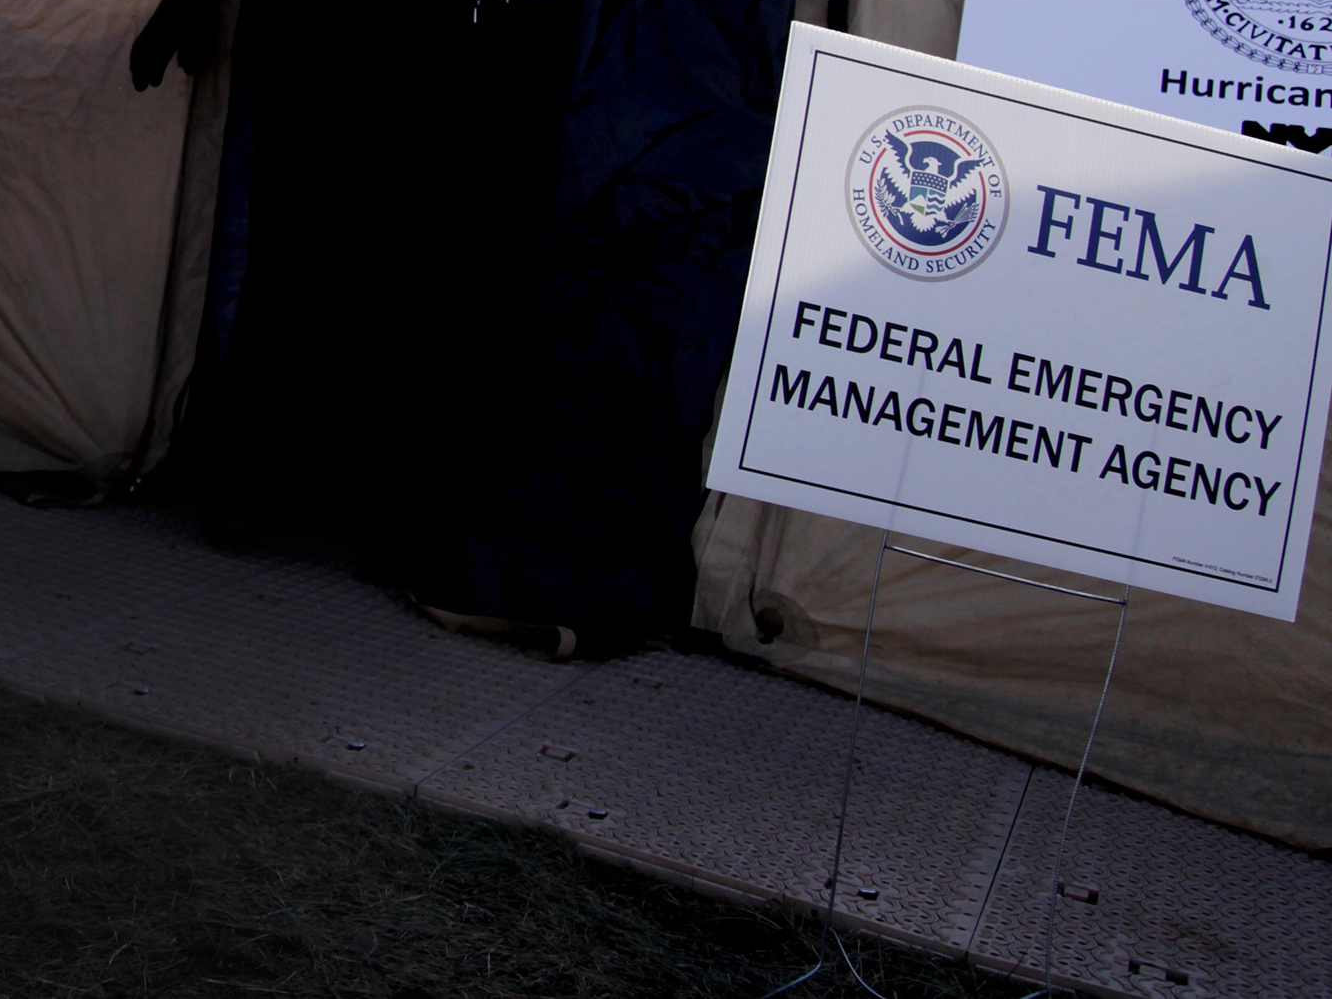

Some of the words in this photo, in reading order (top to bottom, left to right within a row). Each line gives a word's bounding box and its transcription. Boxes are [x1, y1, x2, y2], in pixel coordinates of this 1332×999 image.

[1160, 68, 1332, 109] Hurrican
[859, 135, 887, 165] U.S.
[892, 114, 995, 167] DEPARTMENT
[988, 173, 1002, 198] OF
[852, 188, 919, 271] HOMELAND
[926, 218, 997, 274] SECURITY
[1027, 184, 1271, 311] FEMA
[792, 300, 992, 385] FEDERAL
[1007, 352, 1283, 450] EMERGENCY
[769, 364, 1093, 473] MANAGEMENT
[1099, 443, 1282, 517] AGENCY
